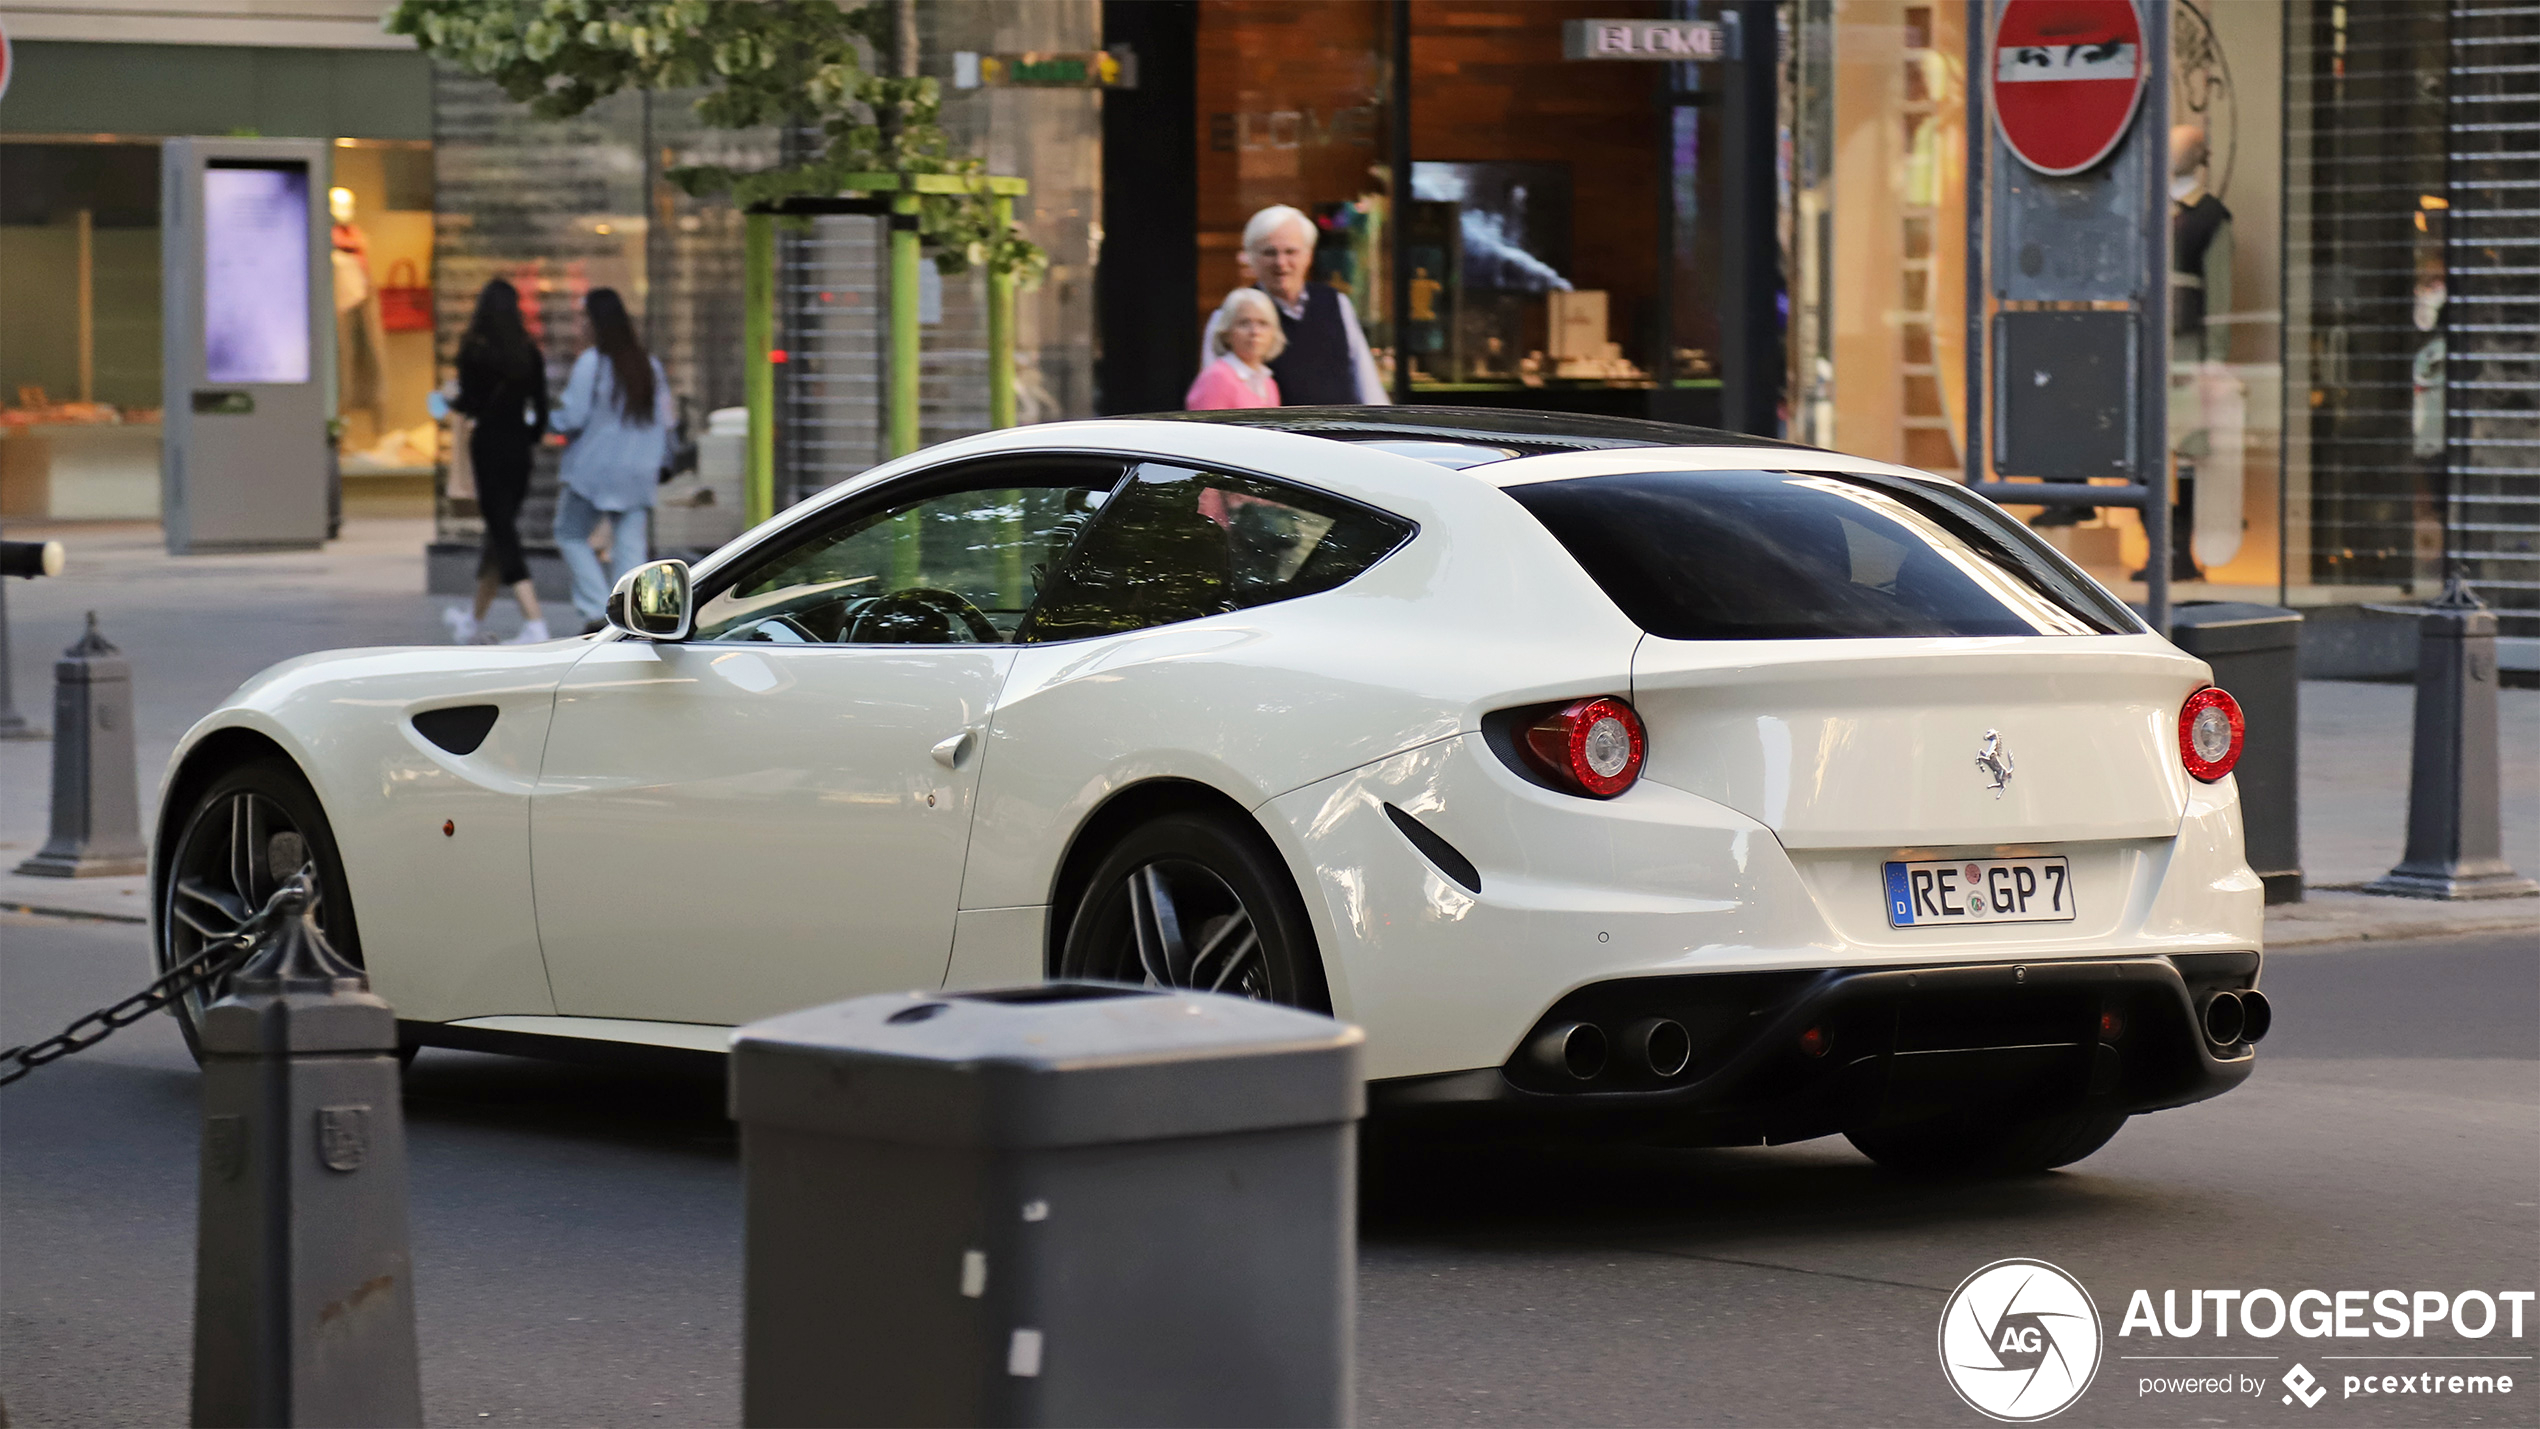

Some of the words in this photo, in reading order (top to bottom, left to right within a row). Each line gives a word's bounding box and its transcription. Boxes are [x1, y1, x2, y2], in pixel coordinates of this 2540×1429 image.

[1911, 869, 1965, 916] RE
[1988, 866, 2037, 914] GP
[2045, 865, 2065, 912] 7
[1896, 901, 1907, 915] D
